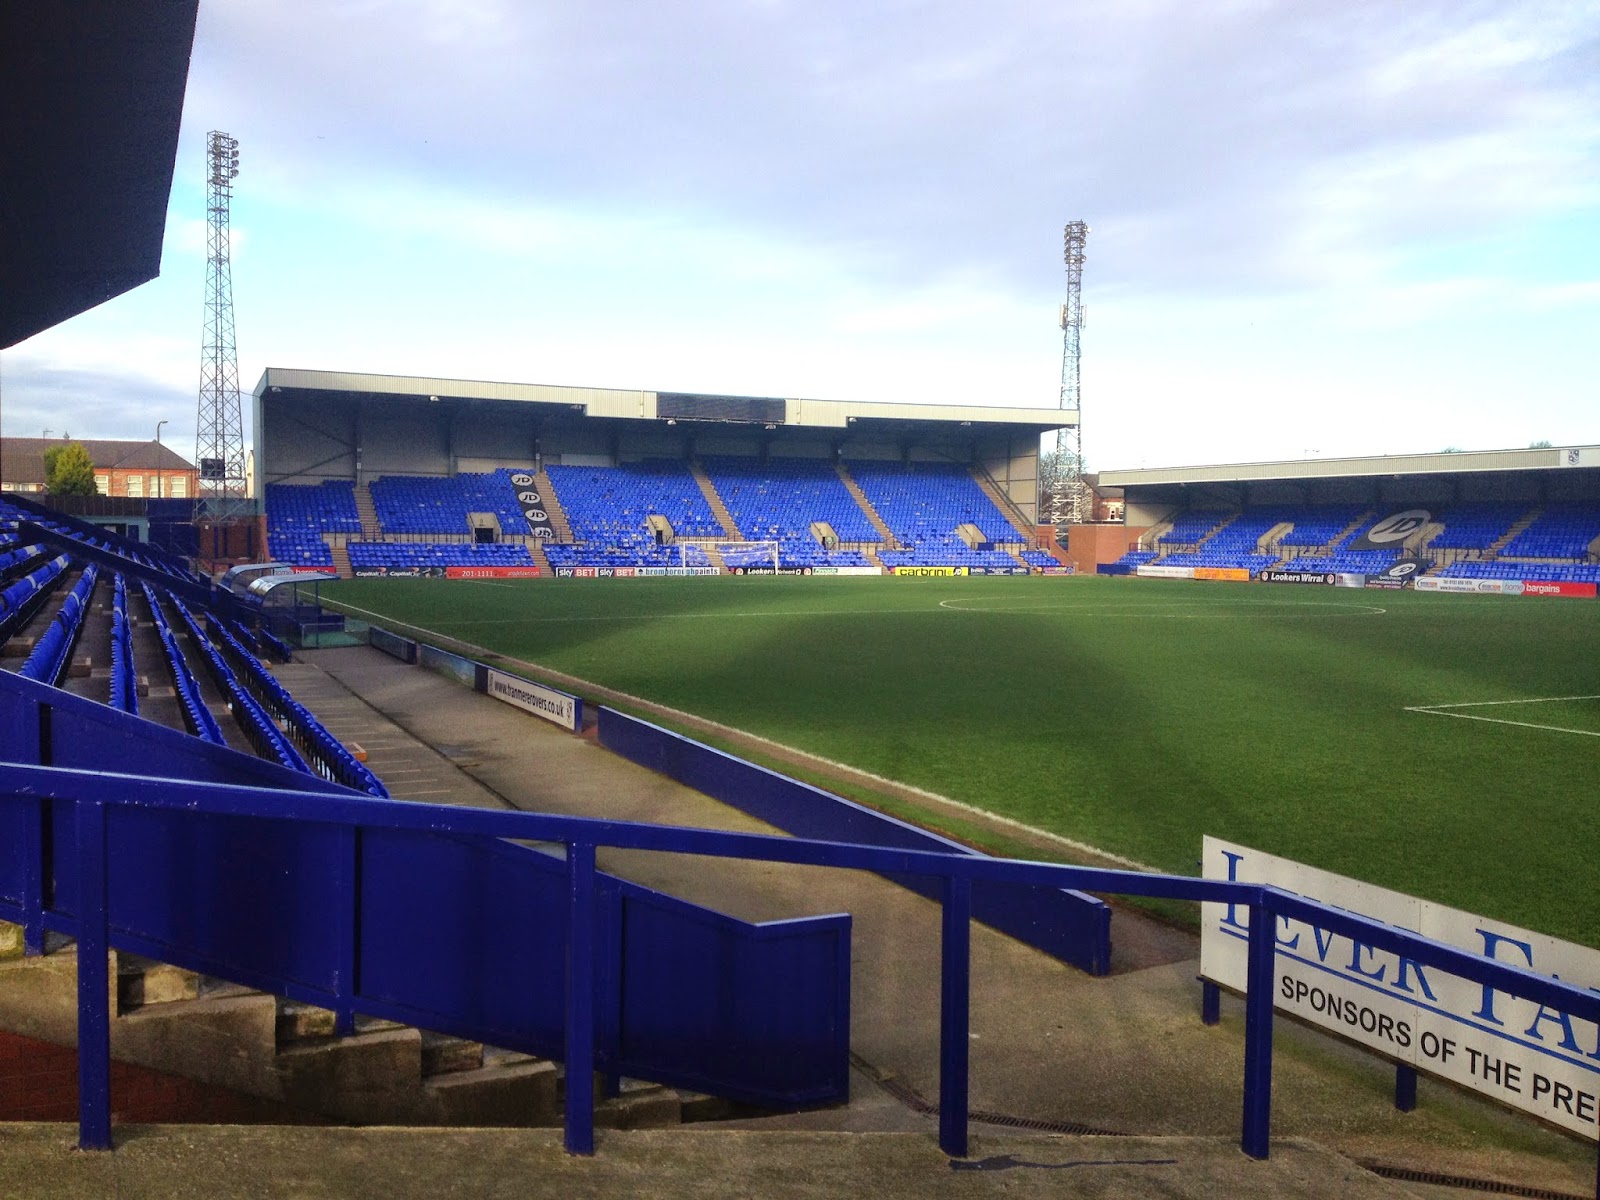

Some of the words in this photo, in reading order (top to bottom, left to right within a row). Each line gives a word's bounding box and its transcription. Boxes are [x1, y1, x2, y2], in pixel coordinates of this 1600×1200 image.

[1372, 517, 1425, 535] JD
[559, 568, 573, 577] sky
[600, 568, 613, 577] sky
[900, 568, 946, 576] carbrini
[1271, 572, 1300, 582] Lookers
[1301, 573, 1324, 582] Wirral
[1526, 583, 1560, 594] bargains
[494, 681, 564, 718] www.tranmererovers.co.uk
[1471, 928, 1600, 1061] FA
[1281, 975, 1412, 1048] SPONSORS
[1420, 1031, 1457, 1065] OF
[1465, 1046, 1522, 1093] THE
[1532, 1073, 1596, 1124] PRE
